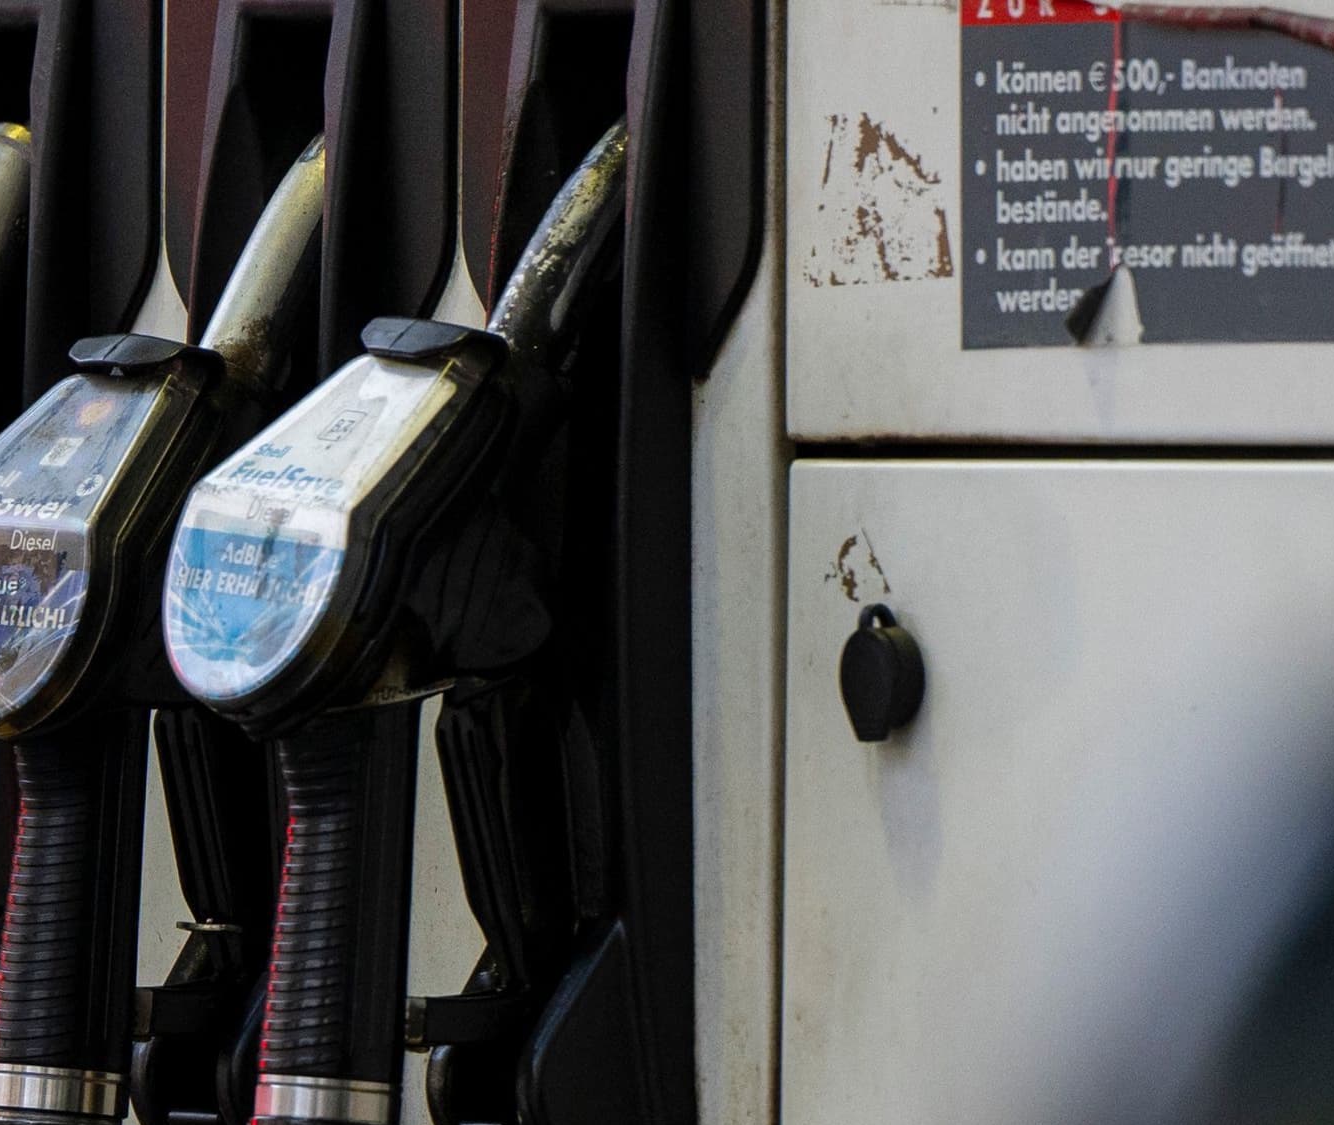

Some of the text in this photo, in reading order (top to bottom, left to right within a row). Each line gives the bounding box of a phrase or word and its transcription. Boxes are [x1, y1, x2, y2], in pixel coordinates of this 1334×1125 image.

[996, 60, 1082, 94] können
[1181, 57, 1307, 91] Banknoten
[996, 96, 1317, 142] nicht angenommen werden.
[996, 149, 1068, 183] haben
[1115, 156, 1160, 180] nur
[1164, 145, 1253, 188] geringe
[996, 189, 1109, 224] bestände.
[996, 237, 1056, 271] kann
[1061, 235, 1102, 269] der
[1181, 233, 1237, 268] nicht
[10, 529, 59, 551] Diesel
